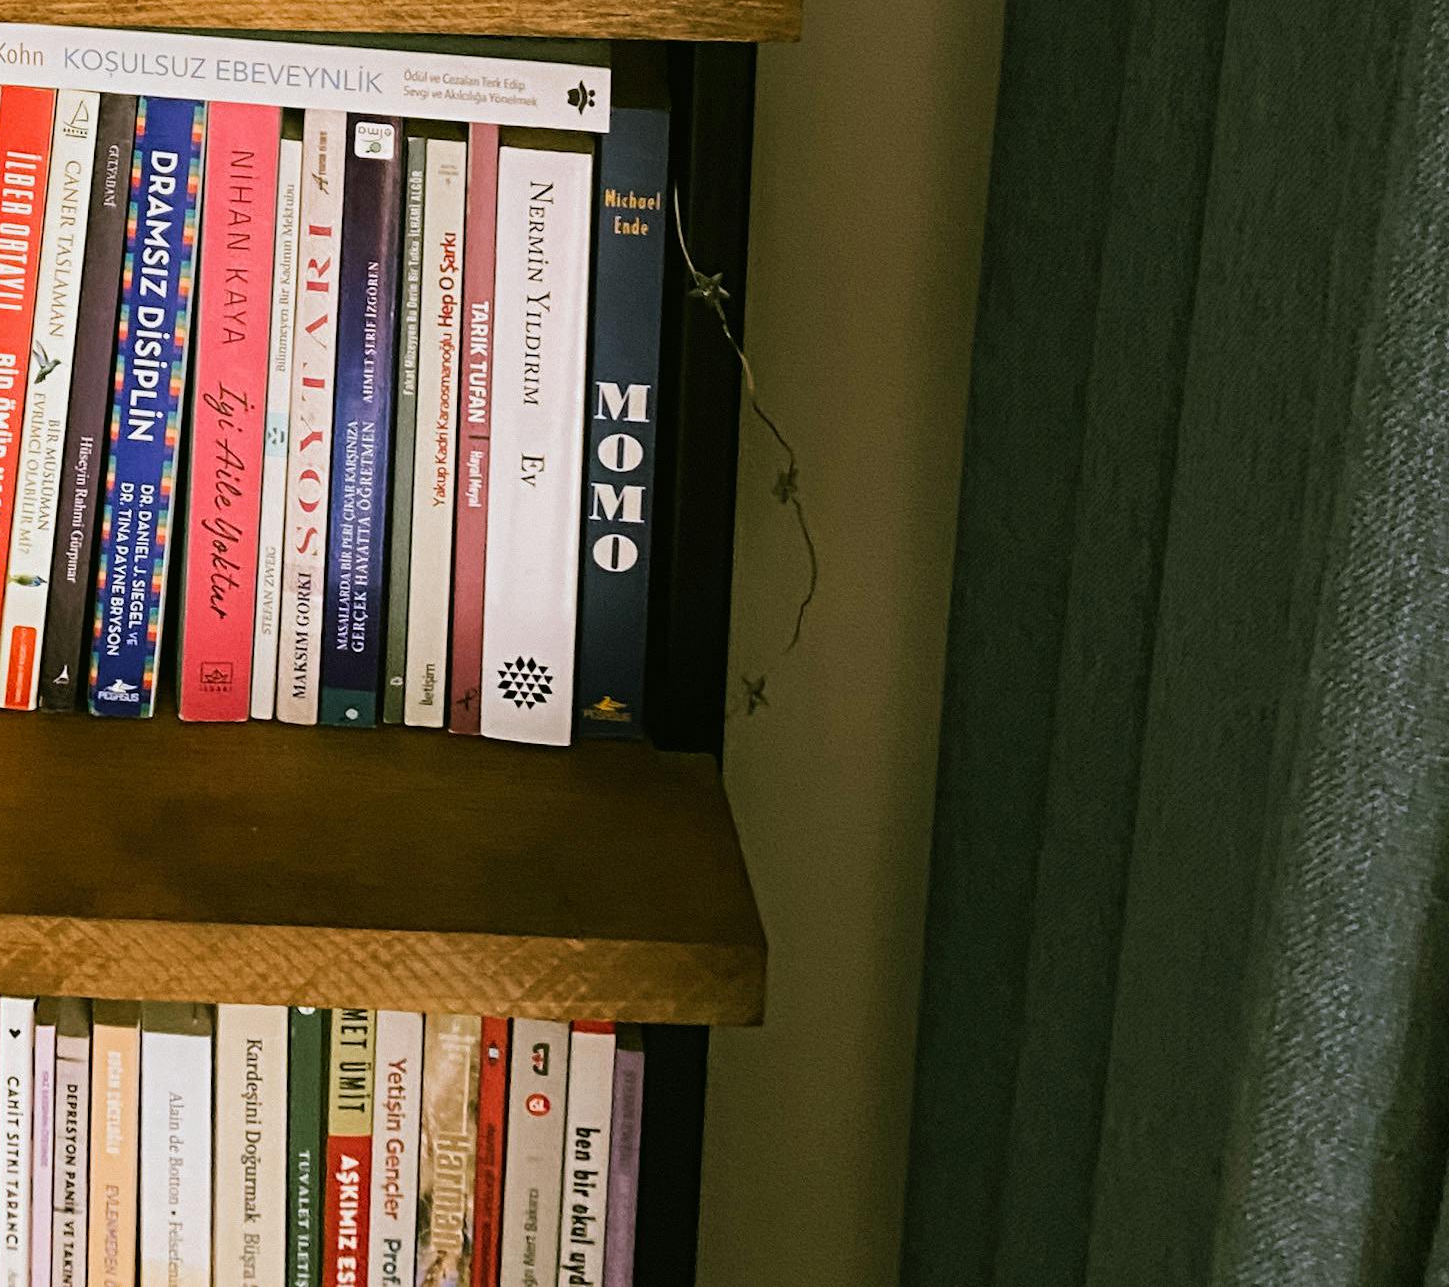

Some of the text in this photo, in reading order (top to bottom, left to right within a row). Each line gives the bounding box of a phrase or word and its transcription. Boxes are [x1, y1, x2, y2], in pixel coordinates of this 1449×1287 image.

[64, 48, 205, 80] KOŞULSUZ
[216, 59, 384, 94] EBEVEYNLİK
[1, 151, 41, 216] İLBER
[604, 189, 660, 210] Michael
[614, 216, 648, 235] Ende
[49, 160, 82, 336] CANER TASLAMAN
[128, 151, 178, 444] DRAMSIZ DİSİPLİN
[222, 151, 255, 345] NİHAN KAYA
[588, 381, 651, 573] MOMO
[106, 482, 135, 656] DR. TINA PAYNE BRYSON
[353, 422, 375, 653] GERÇEK HAYATTA ÖĞRETMEN
[244, 1039, 264, 1124] Kardeşini
[168, 1092, 185, 1203] Alain de Botton
[242, 1131, 262, 1223] Doğurmak
[383, 1059, 407, 1220] Yetişin Gençler
[574, 1127, 600, 1161] ben
